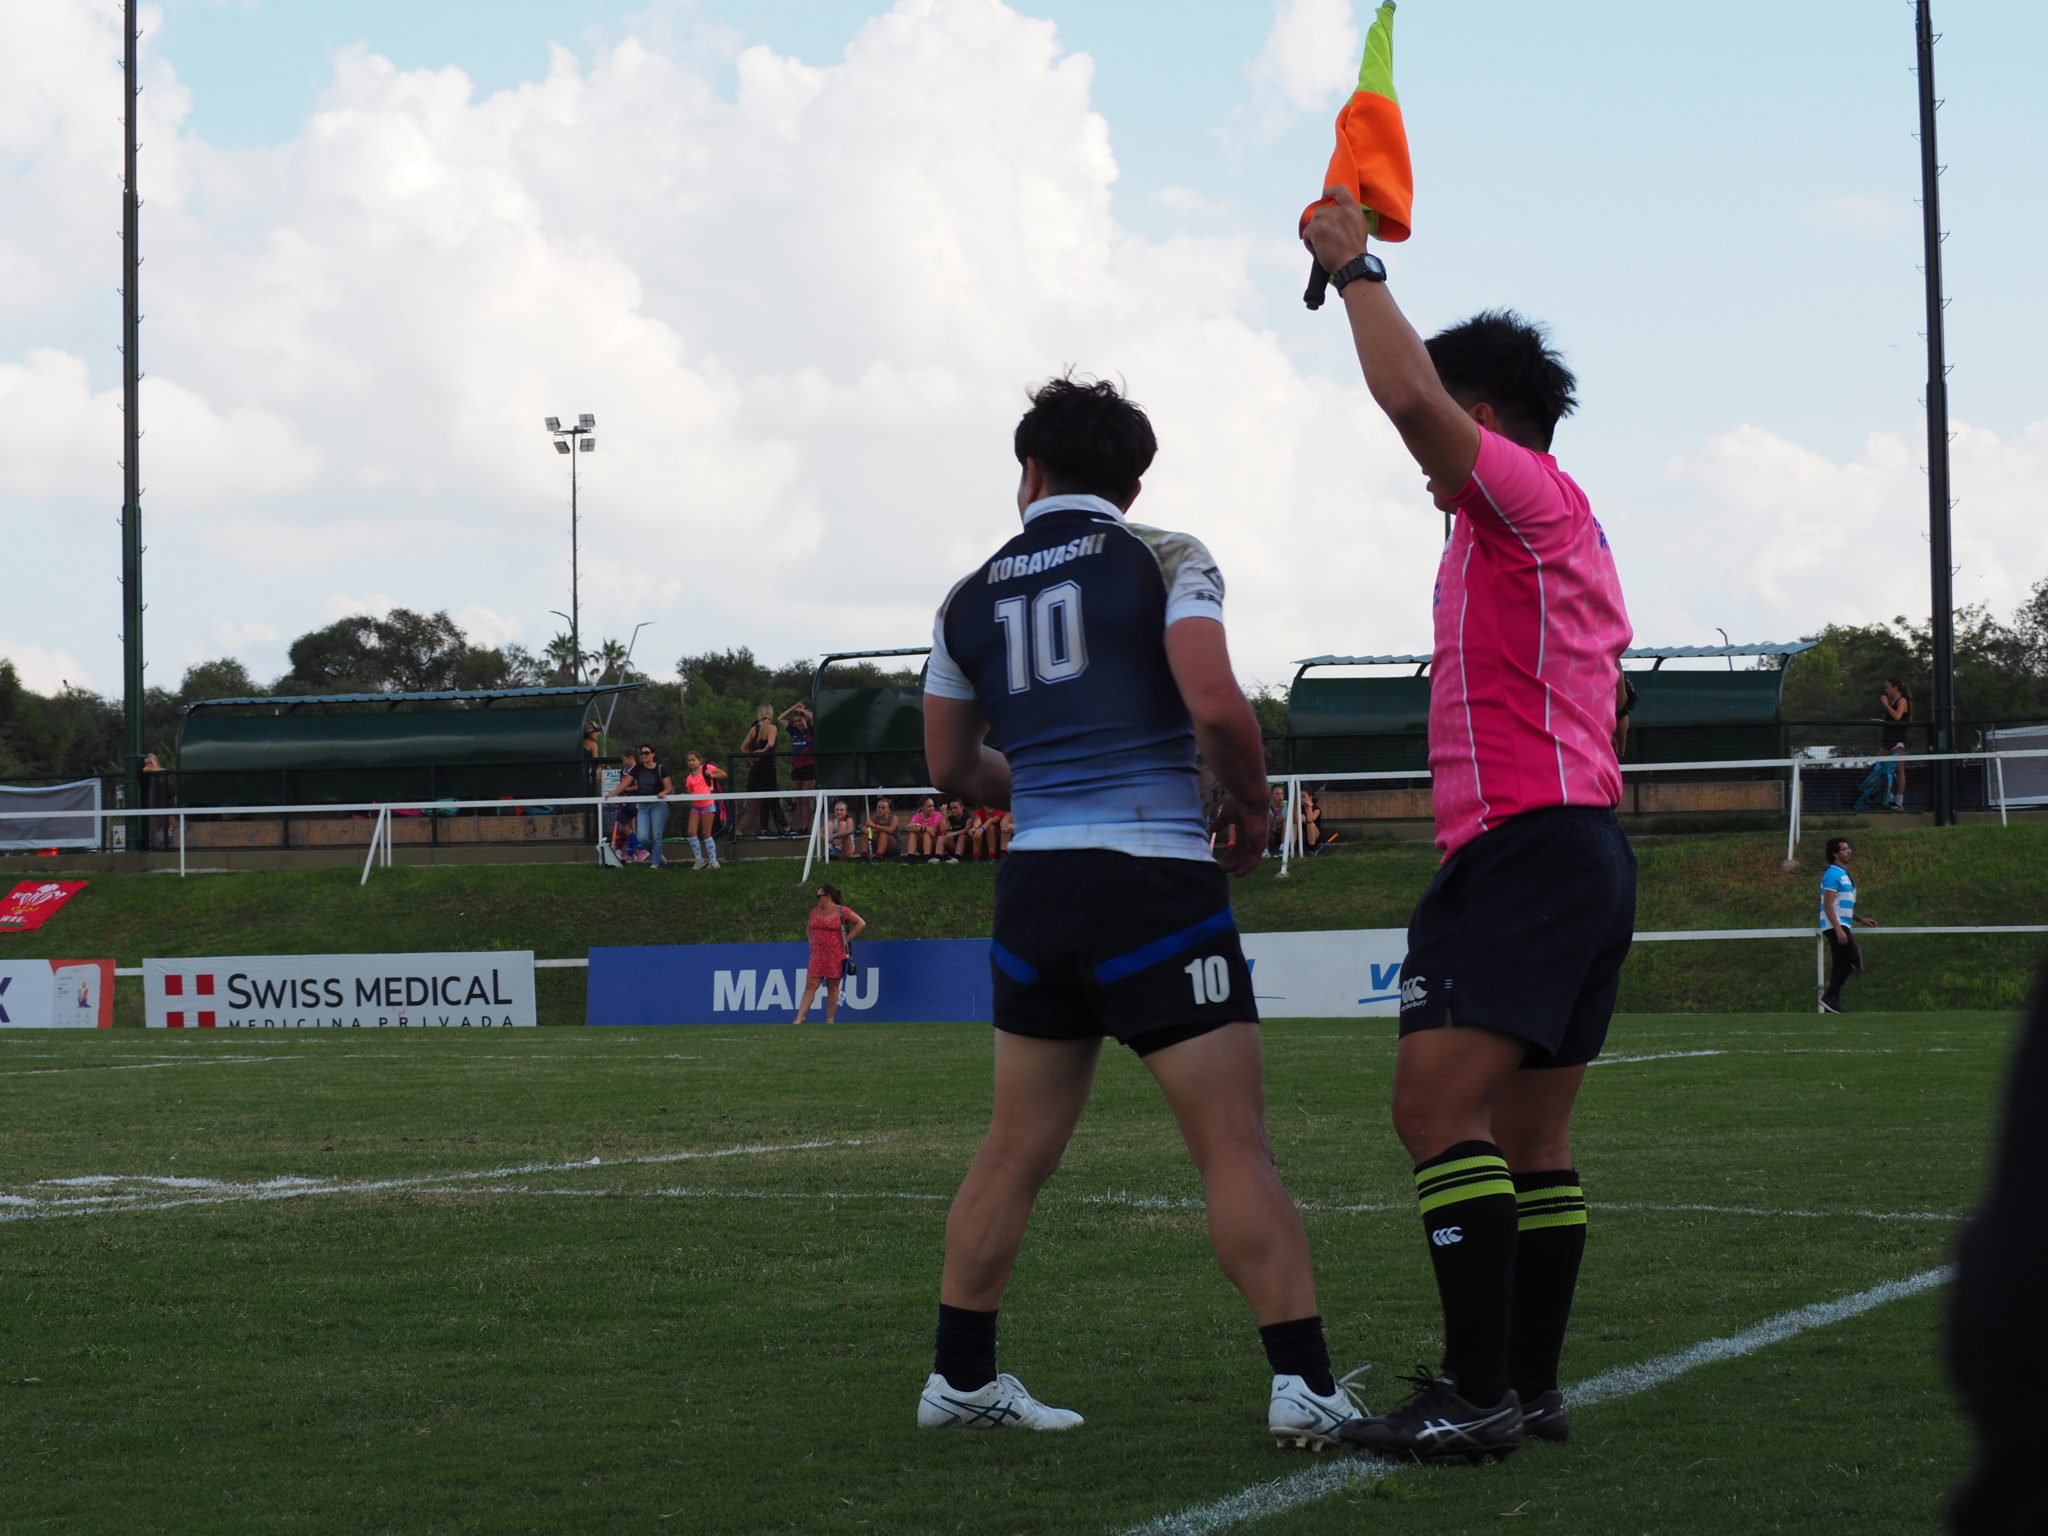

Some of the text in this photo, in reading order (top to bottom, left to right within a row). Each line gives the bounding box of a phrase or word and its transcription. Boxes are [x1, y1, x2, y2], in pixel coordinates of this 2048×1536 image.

[987, 533, 1106, 584] KOBAYASHI
[994, 580, 1089, 694] 10
[227, 969, 513, 1010] SWISS MEDICAL
[713, 967, 879, 1012] MAIU
[1184, 955, 1231, 1005] 10
